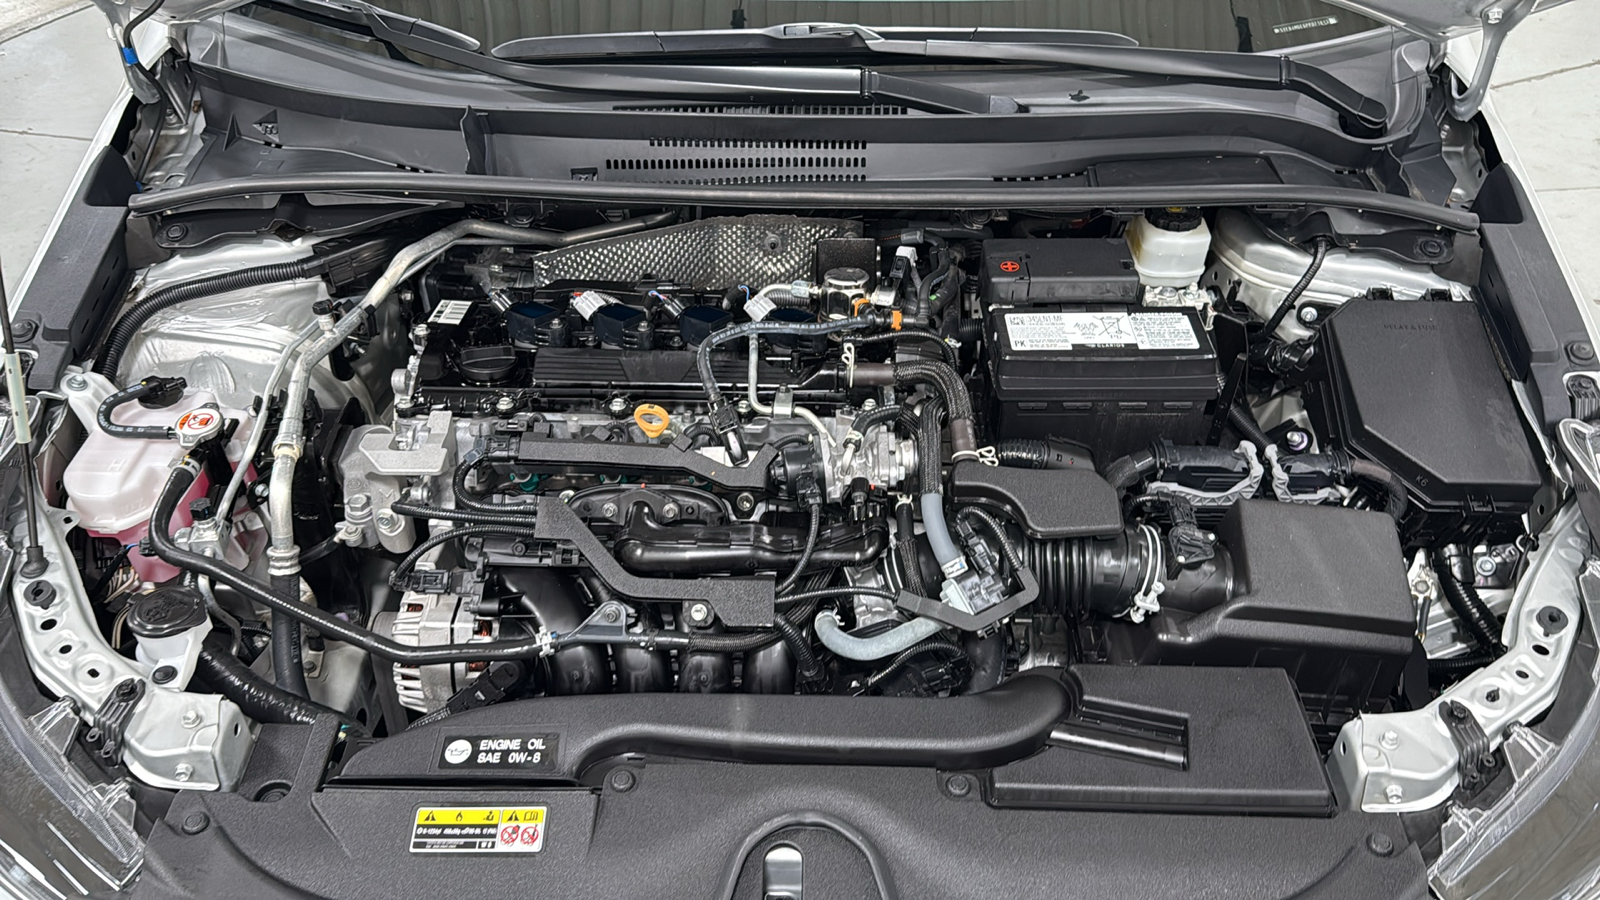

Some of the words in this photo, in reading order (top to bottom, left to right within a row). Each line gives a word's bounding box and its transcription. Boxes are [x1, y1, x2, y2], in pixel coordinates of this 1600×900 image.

[479, 739, 522, 750] ENGINE
[527, 738, 546, 750] OIL
[477, 752, 501, 763] SAE
[508, 752, 541, 763] 0W-8
